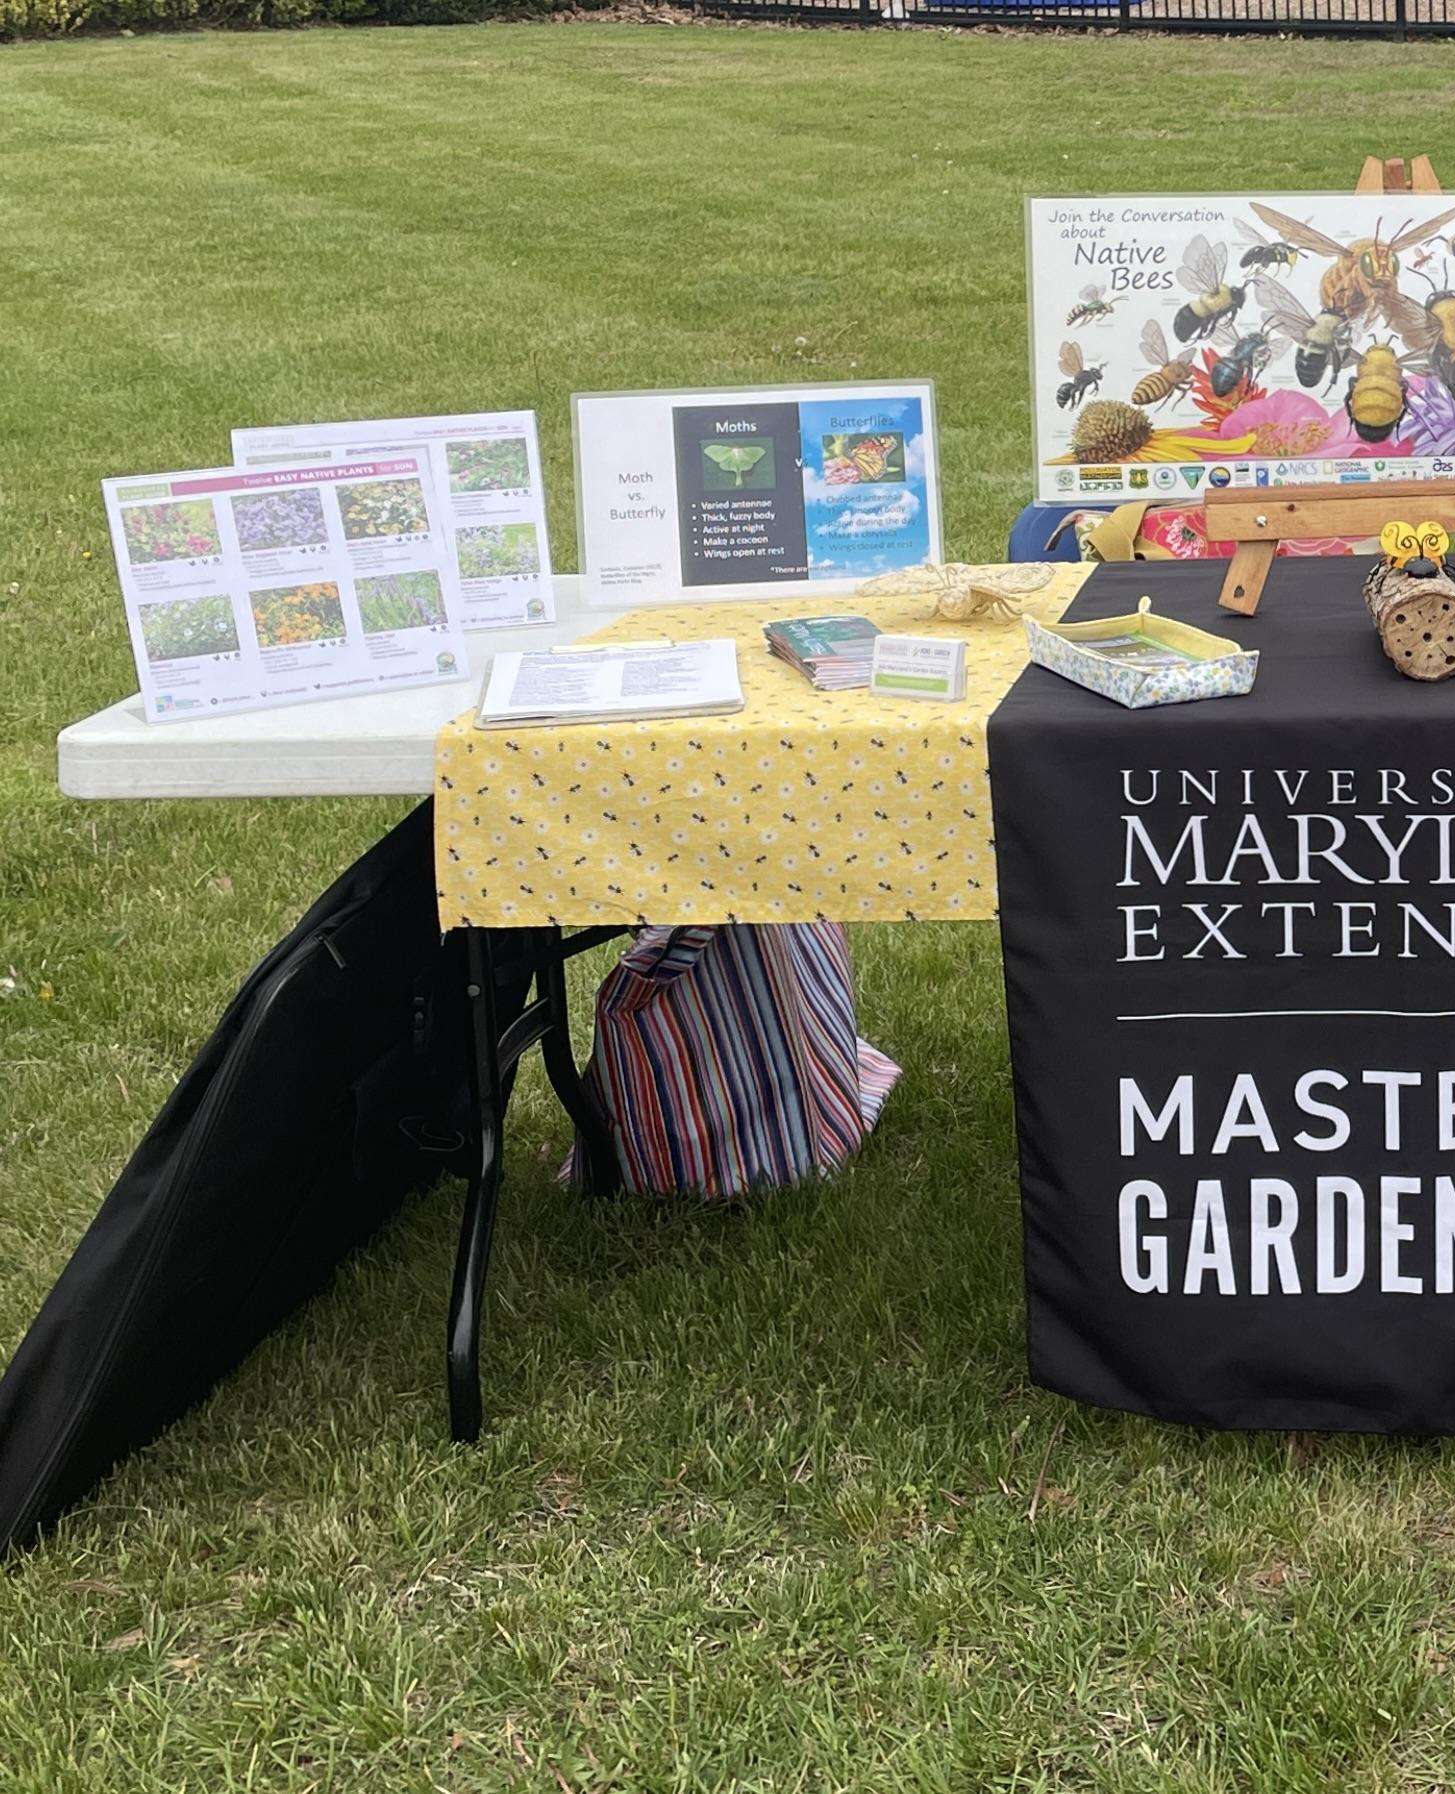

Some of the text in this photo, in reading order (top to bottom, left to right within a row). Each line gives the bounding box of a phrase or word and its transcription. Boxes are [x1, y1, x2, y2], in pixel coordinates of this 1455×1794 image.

[1048, 207, 1225, 223] Join the Conversation
[1061, 225, 1107, 239] about
[1074, 239, 1167, 266] Native
[1111, 266, 1174, 291] Bees
[715, 420, 758, 433] Moths
[830, 416, 896, 429] Butterflies
[242, 476, 273, 486] Twelve
[274, 473, 299, 484] EASY
[300, 470, 335, 481] NATIVE
[337, 466, 375, 477] PLANTS
[394, 461, 414, 472] SUN
[618, 471, 654, 484] Moth
[627, 492, 645, 501] vs.
[701, 499, 773, 510] Varied antennae
[610, 505, 666, 520] Butterfly
[701, 510, 776, 522] Thick, fuzzy body
[702, 523, 765, 534] Active at night
[703, 537, 728, 546] Make
[736, 536, 769, 545] cocoon
[704, 546, 785, 559] Wings open at rest
